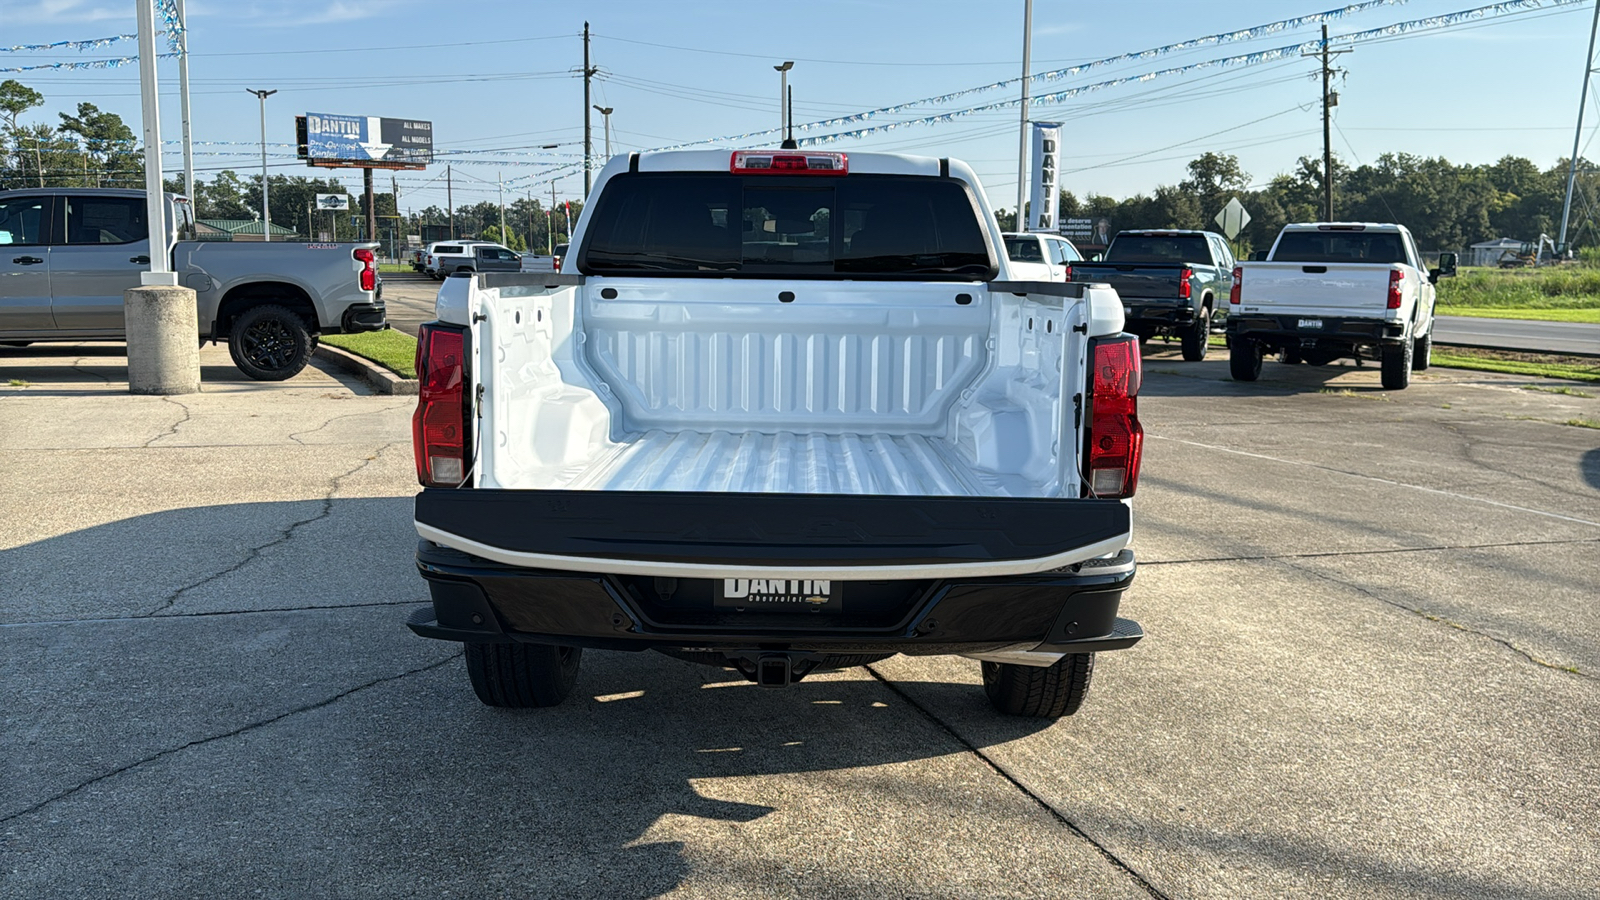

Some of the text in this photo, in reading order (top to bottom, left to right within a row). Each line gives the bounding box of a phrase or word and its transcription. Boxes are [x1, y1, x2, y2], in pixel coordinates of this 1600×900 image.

[309, 116, 359, 134] DANTIN
[401, 135, 431, 144] ALL MODELS
[310, 149, 338, 157] Center
[1039, 140, 1056, 228] DANTIN
[1298, 319, 1323, 329] DANTIN
[749, 595, 802, 603] Chevrolet
